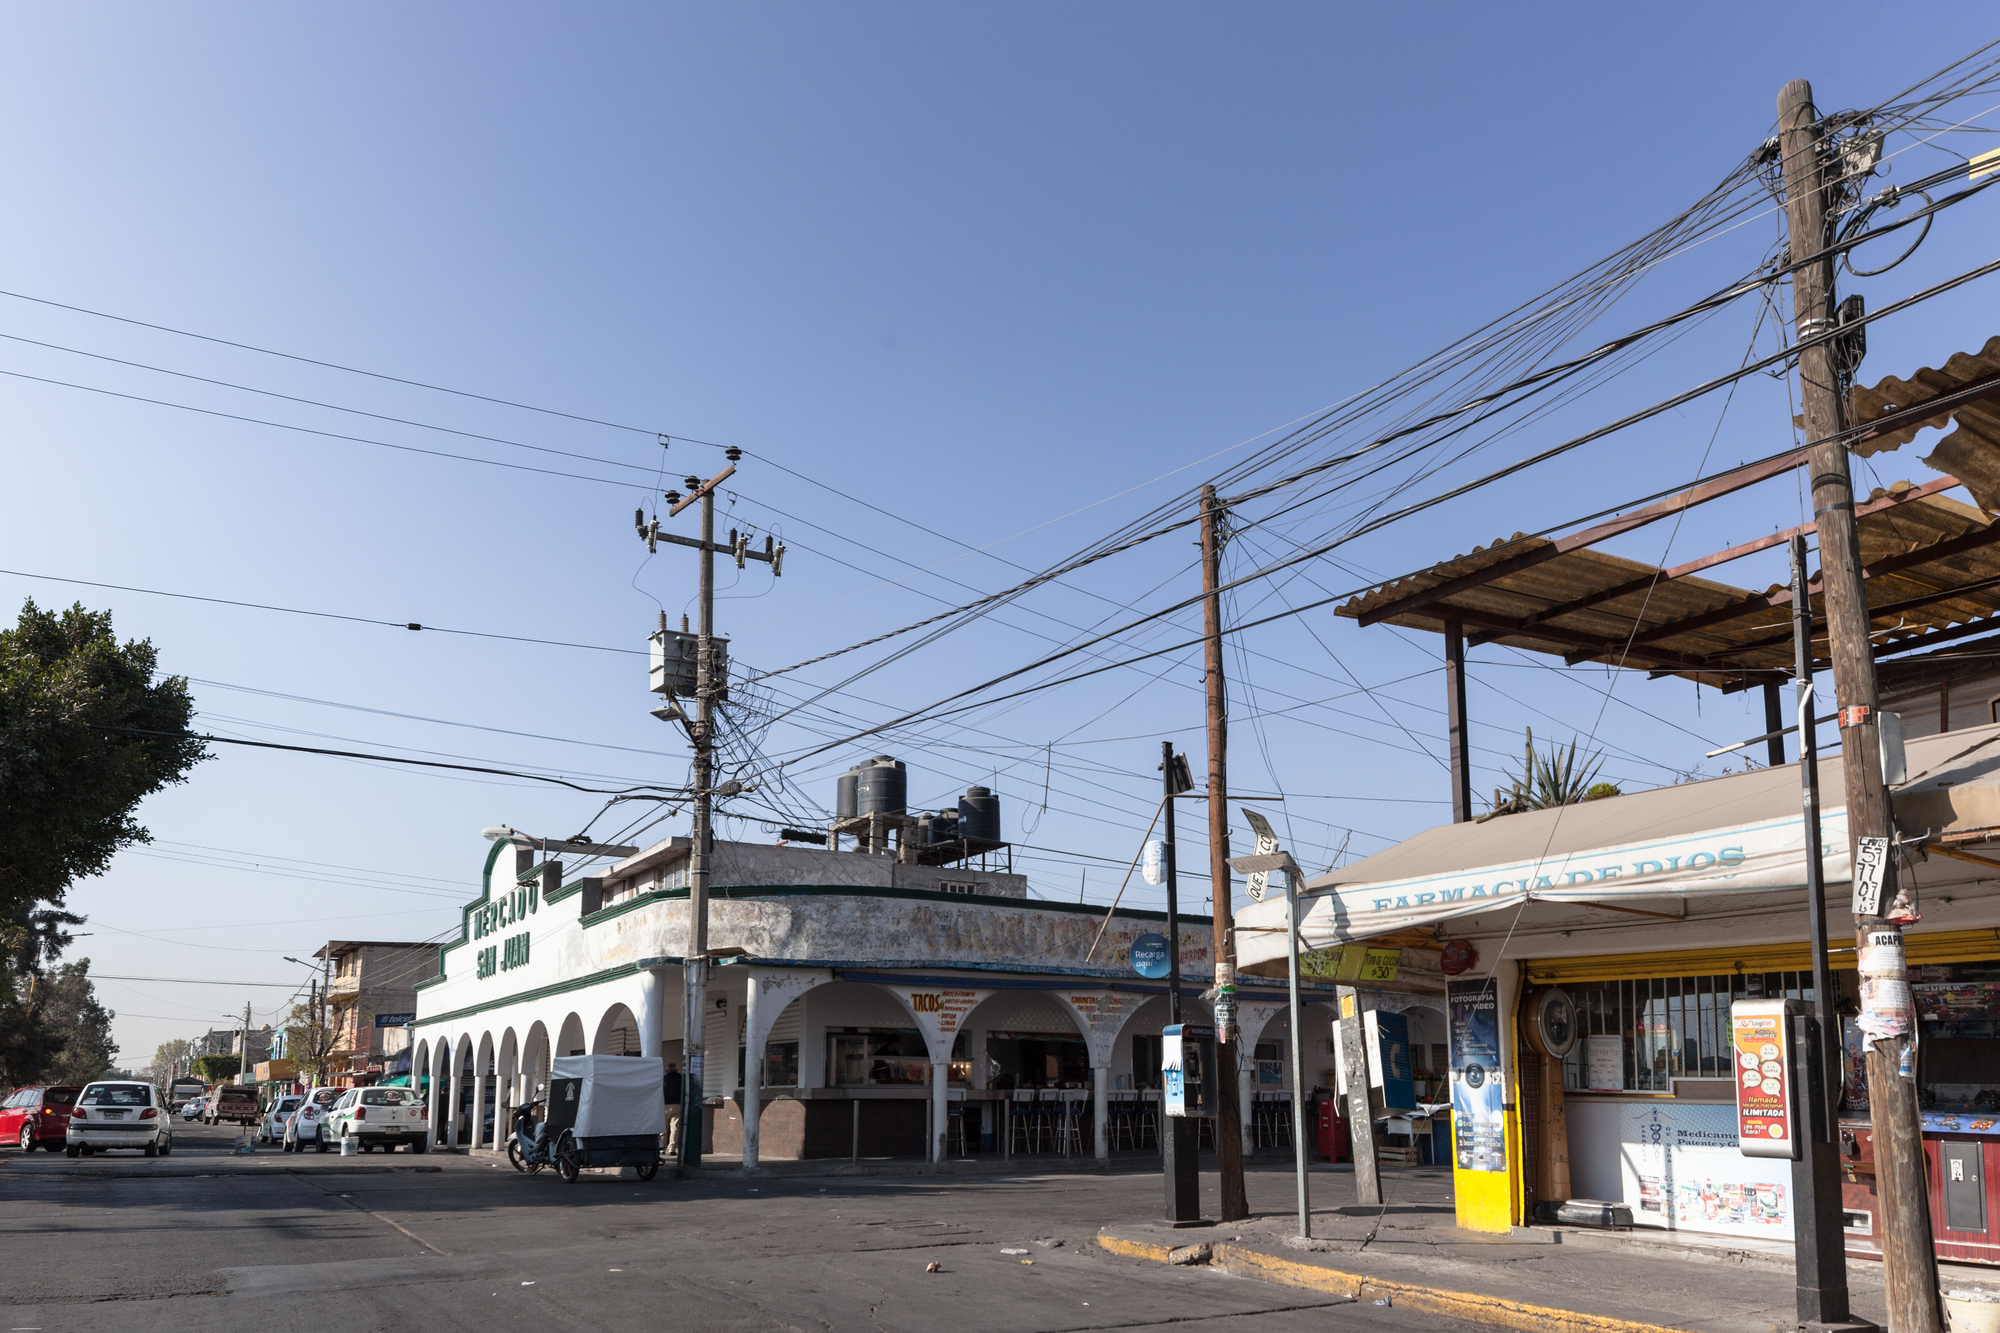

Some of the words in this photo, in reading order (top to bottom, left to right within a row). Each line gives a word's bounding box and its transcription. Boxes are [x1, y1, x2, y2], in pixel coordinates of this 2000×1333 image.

[1372, 875, 1554, 912] FARMACIA
[1565, 865, 1623, 885] DE
[1631, 846, 1747, 876] DIOS
[477, 945, 497, 981] SAN
[500, 931, 530, 972] JUAN
[1135, 951, 1165, 960] Recarga
[1135, 959, 1154, 969] aquí
[910, 993, 941, 1012] TACOS
[1071, 996, 1099, 1005] CARNITAS
[1742, 1108, 1784, 1117] ILIMITADA
[1677, 1130, 1740, 1139] Medicame
[1677, 1138, 1717, 1146] Patente
